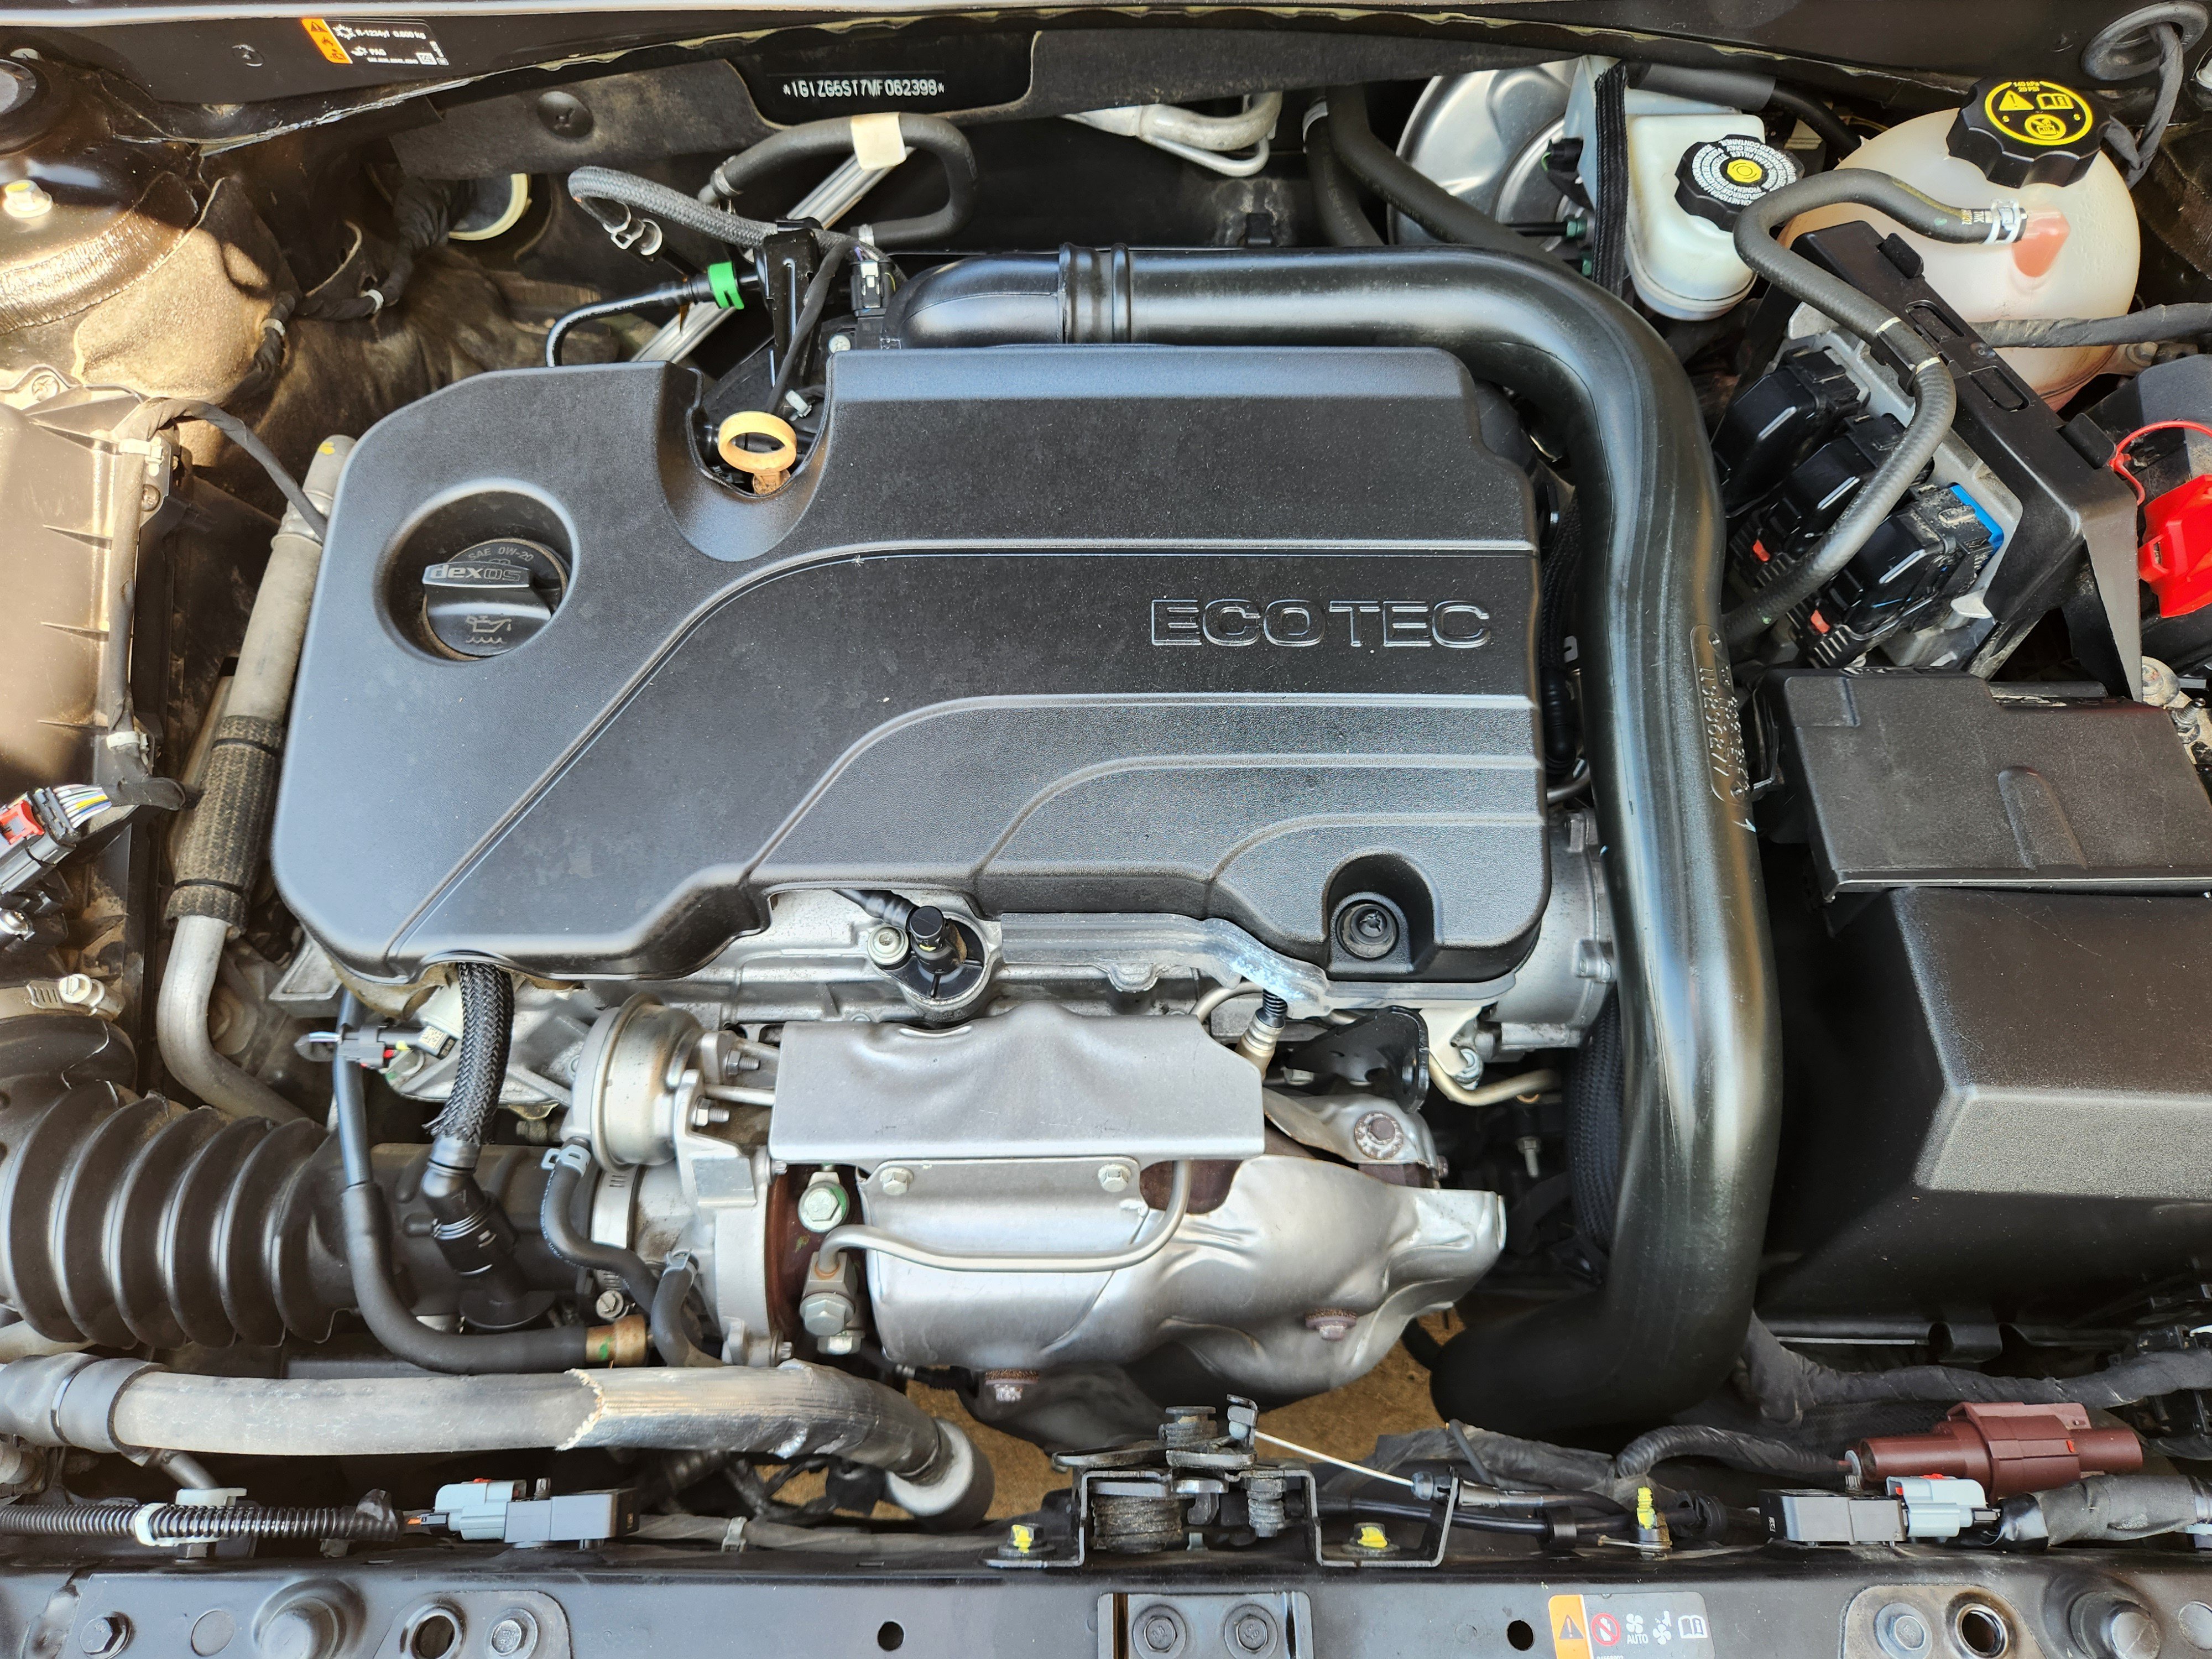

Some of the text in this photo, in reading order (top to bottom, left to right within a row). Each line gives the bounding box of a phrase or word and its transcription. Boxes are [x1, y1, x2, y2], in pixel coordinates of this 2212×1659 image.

[1726, 144, 1744, 153] ONLY
[468, 546, 534, 562] SAE 0W-20
[430, 565, 521, 582] dexos
[1151, 599, 1491, 648] ECOTEC
[1626, 1634, 1648, 1645] AUTO
